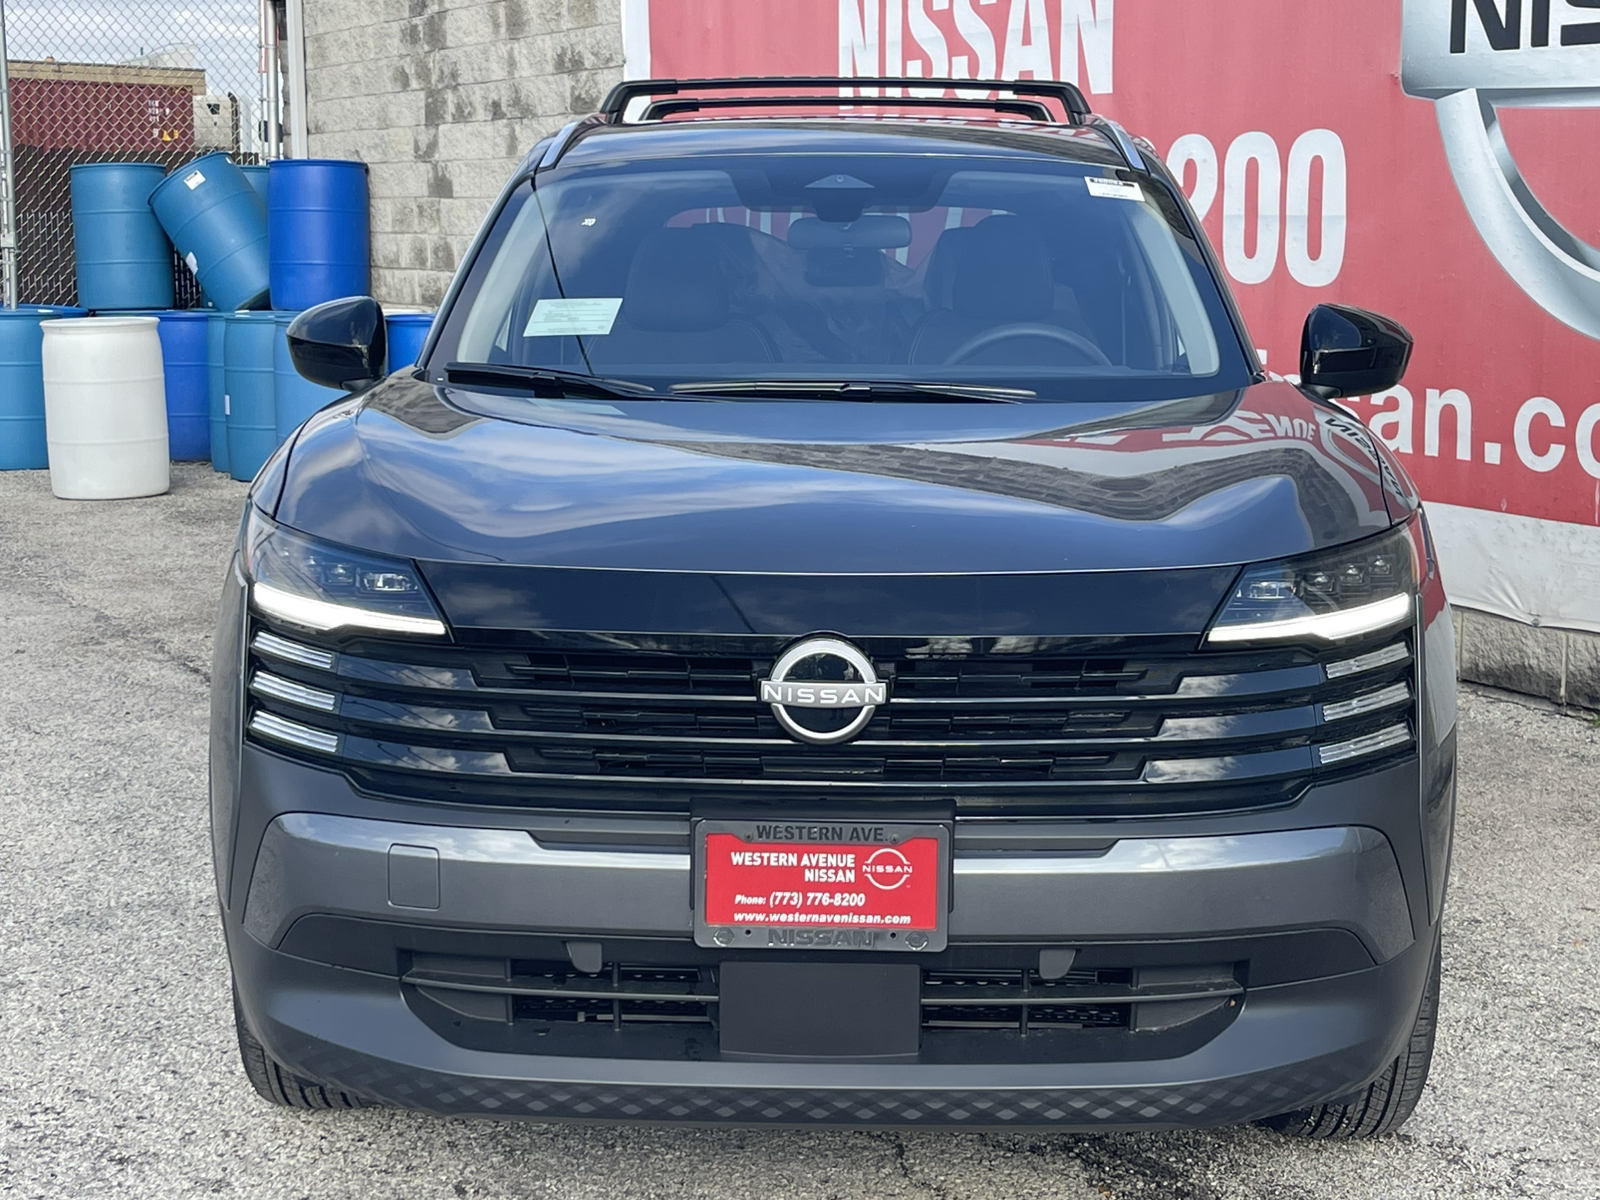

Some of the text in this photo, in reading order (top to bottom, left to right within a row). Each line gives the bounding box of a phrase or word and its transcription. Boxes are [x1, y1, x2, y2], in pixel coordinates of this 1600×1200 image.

[838, 0, 1113, 109] NISSAN
[1140, 128, 1347, 287] 200
[764, 685, 883, 704] NISSAN
[756, 825, 888, 842] WESTERN AVE.
[731, 851, 855, 867] WESTERN AVENUE
[804, 869, 855, 883] NISSAN
[862, 864, 913, 874] NISSAN
[734, 891, 865, 908] Phone: (773) 776-8200
[734, 912, 911, 924] www.westernavenissan.com
[768, 929, 876, 948] NISSAN
